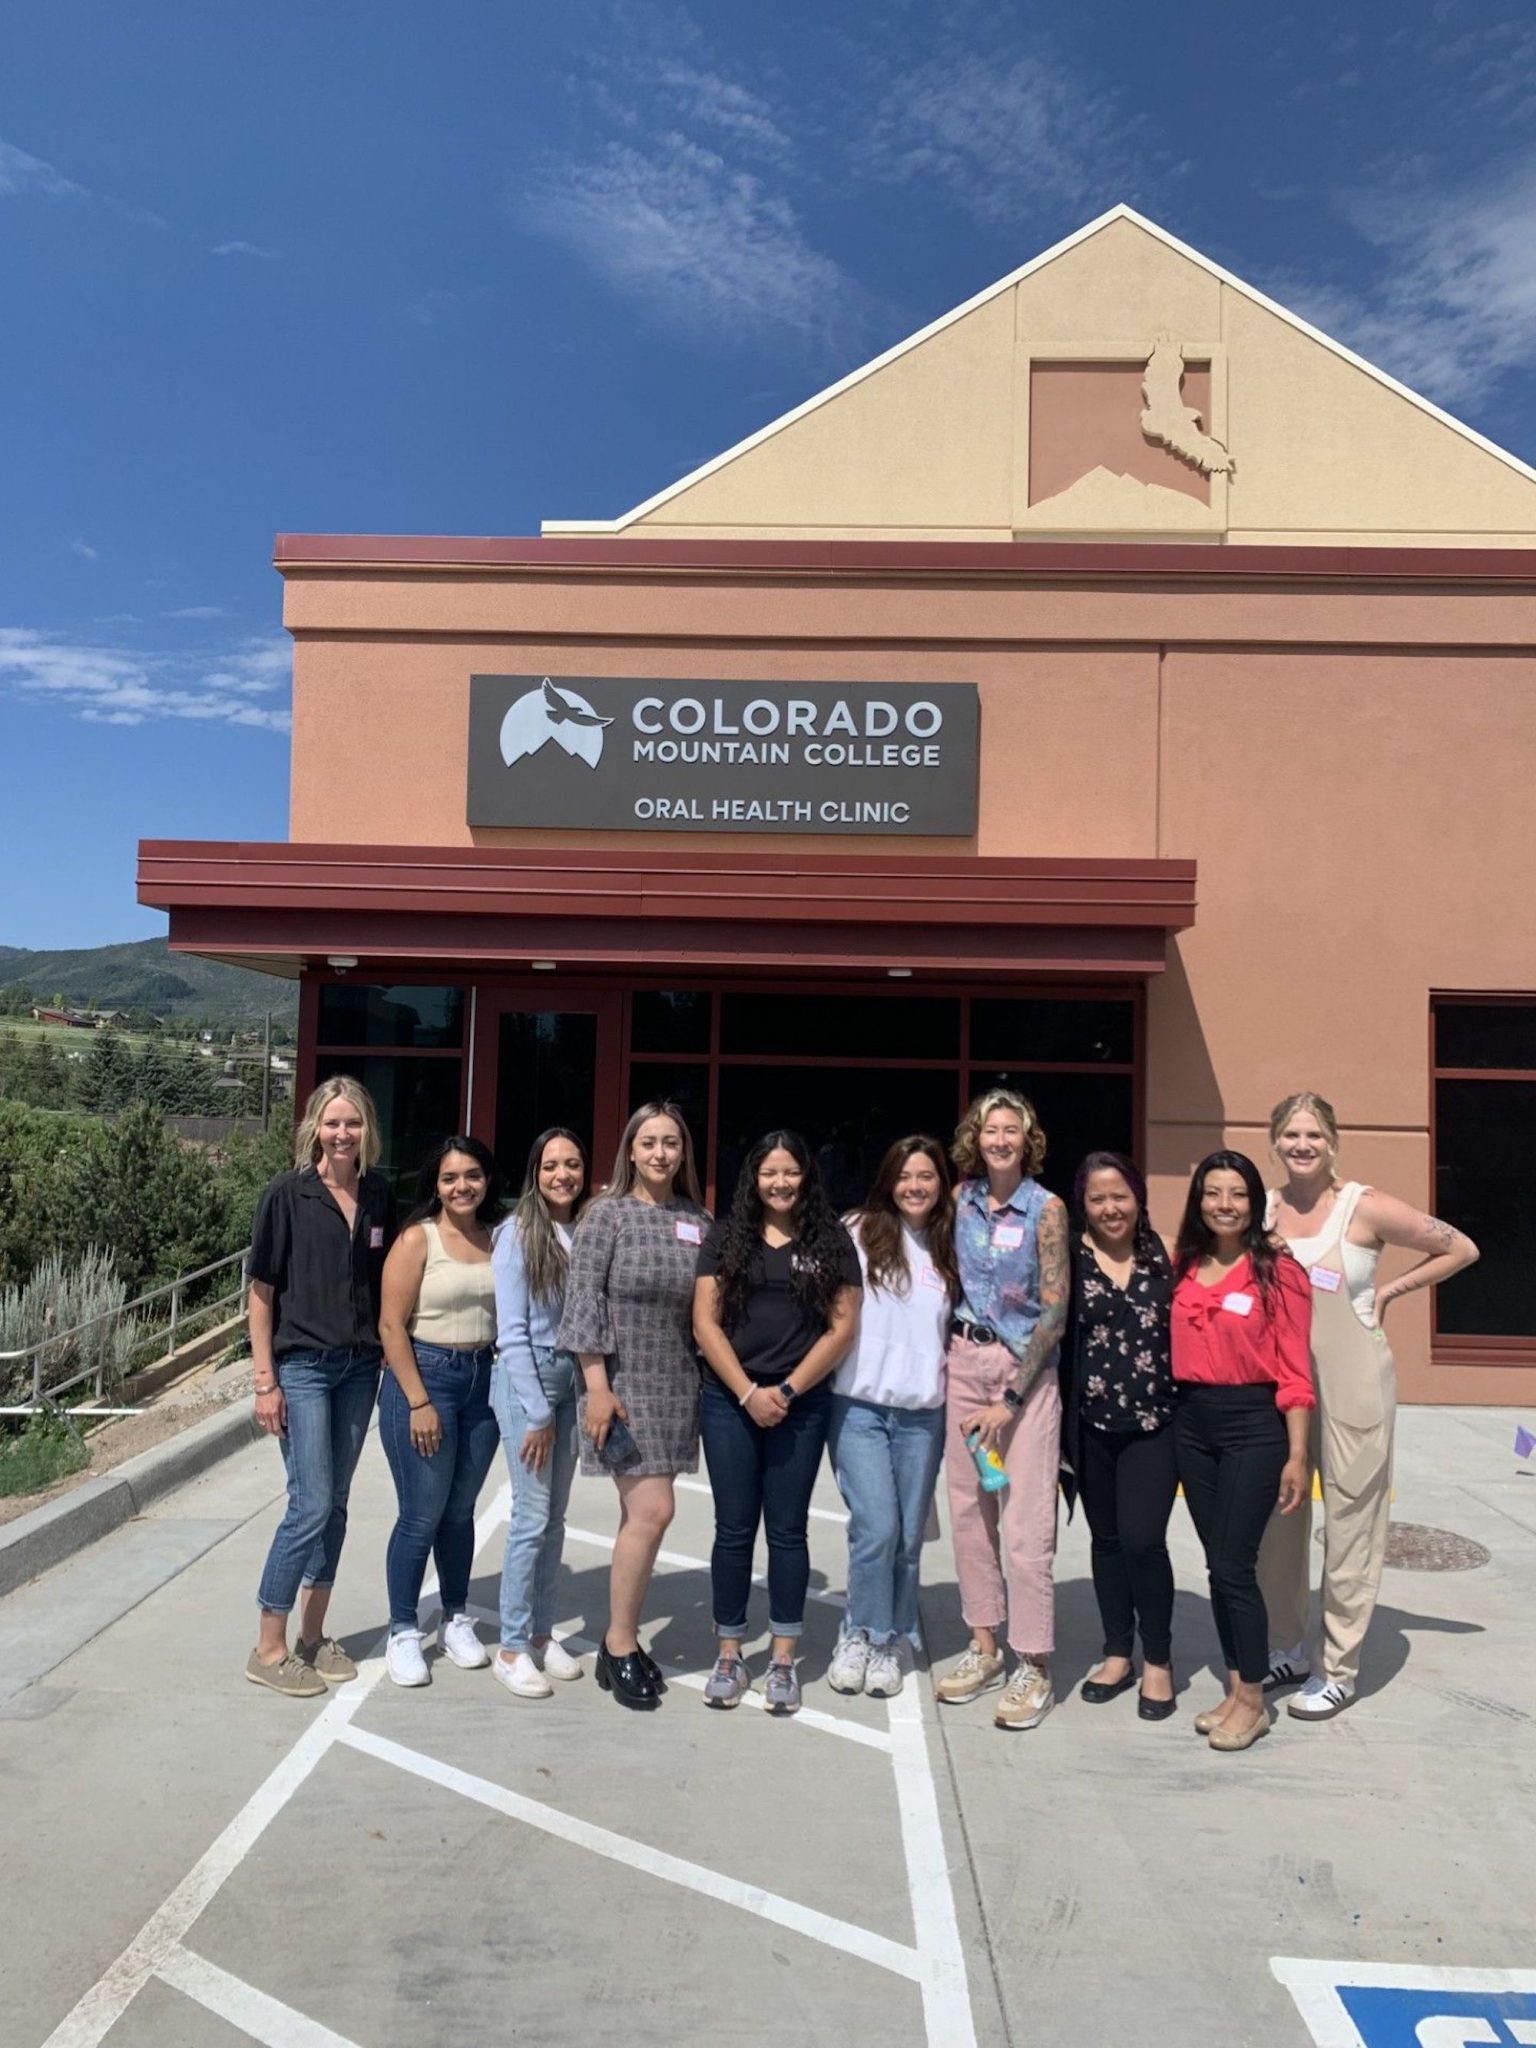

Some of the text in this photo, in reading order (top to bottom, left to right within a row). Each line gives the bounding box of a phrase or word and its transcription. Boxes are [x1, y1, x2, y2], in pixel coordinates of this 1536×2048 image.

[632, 697, 943, 738] COLORADO
[633, 740, 940, 767] MOUNTAIN COLLEGE
[634, 797, 910, 823] ORAL HEALTH CLINIC
